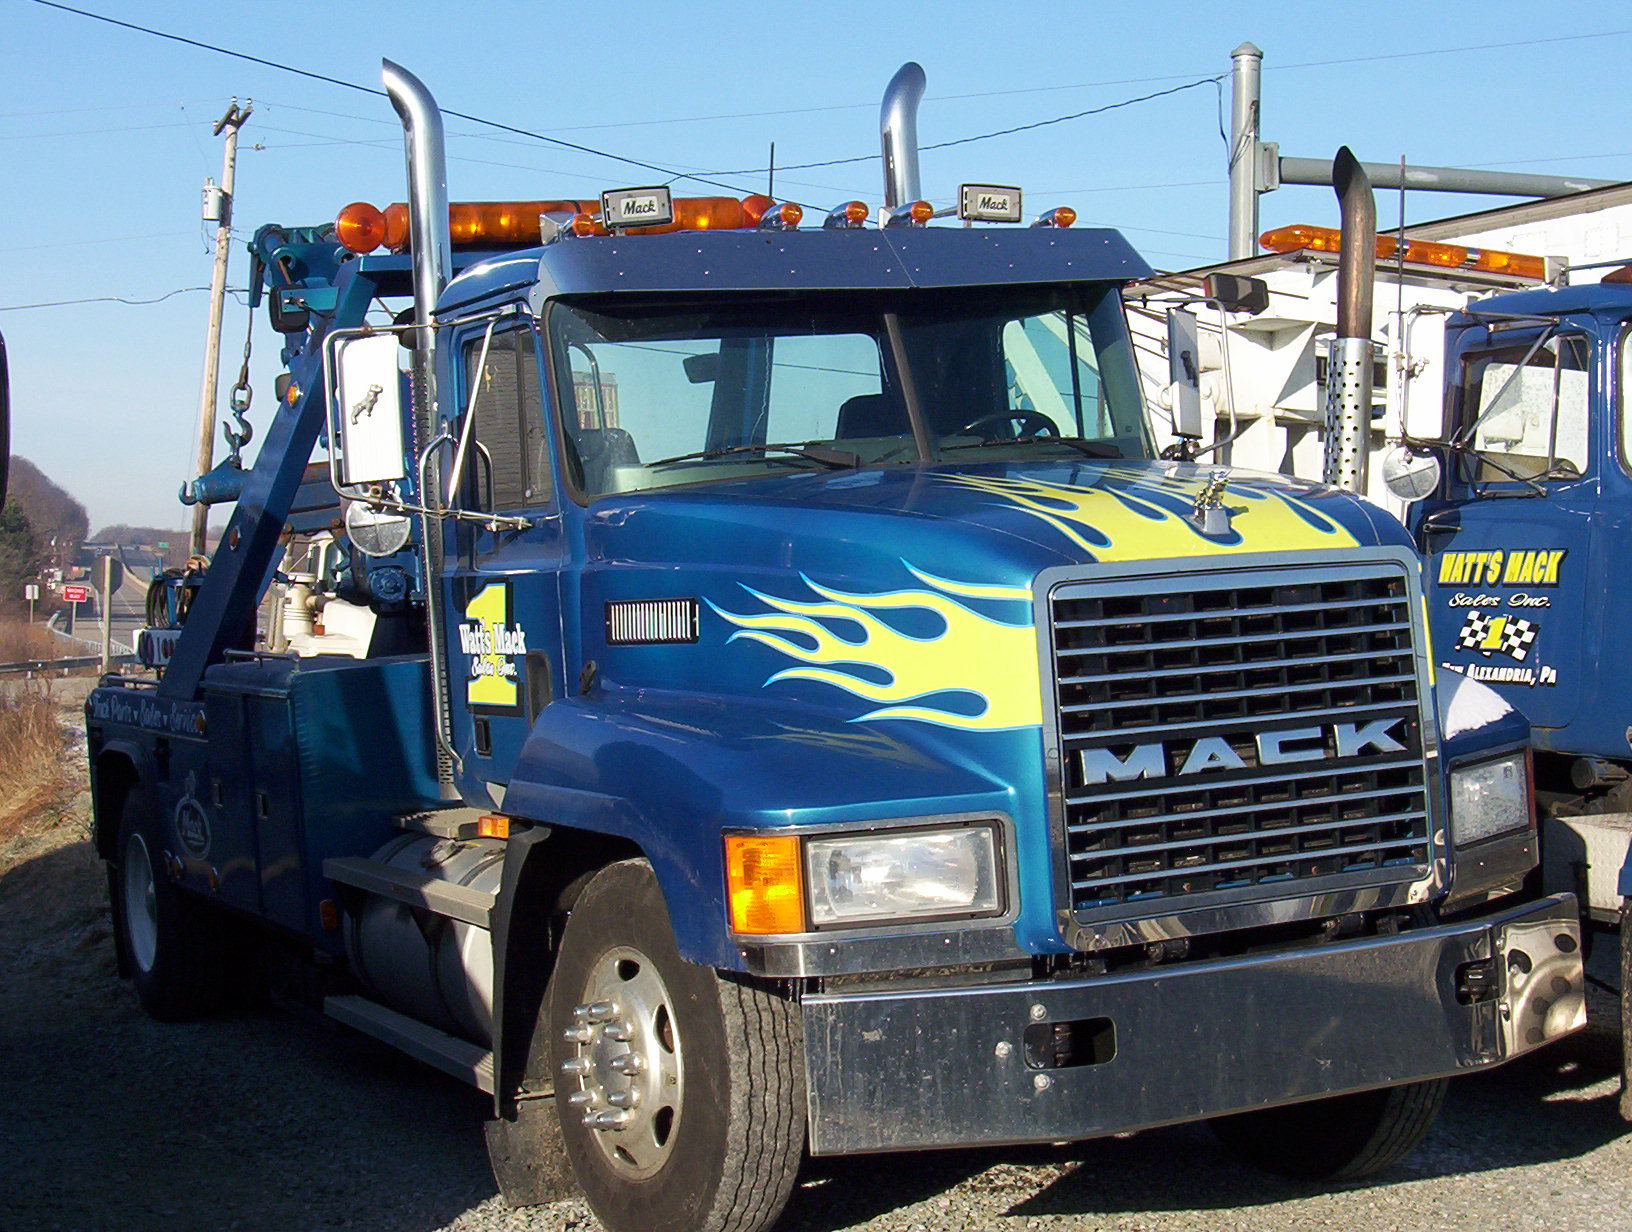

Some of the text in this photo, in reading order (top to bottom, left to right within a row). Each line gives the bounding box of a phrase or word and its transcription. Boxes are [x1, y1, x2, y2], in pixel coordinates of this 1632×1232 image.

[623, 199, 656, 215] Mack
[979, 196, 1008, 211] Mack
[1438, 550, 1565, 586] WATT'S MACK
[1448, 593, 1502, 608] Sales
[458, 617, 527, 655] Watt's Mack
[465, 582, 518, 706] 1
[1479, 616, 1508, 651] 1
[471, 656, 495, 677] Sales
[1079, 717, 1409, 786] MACK
